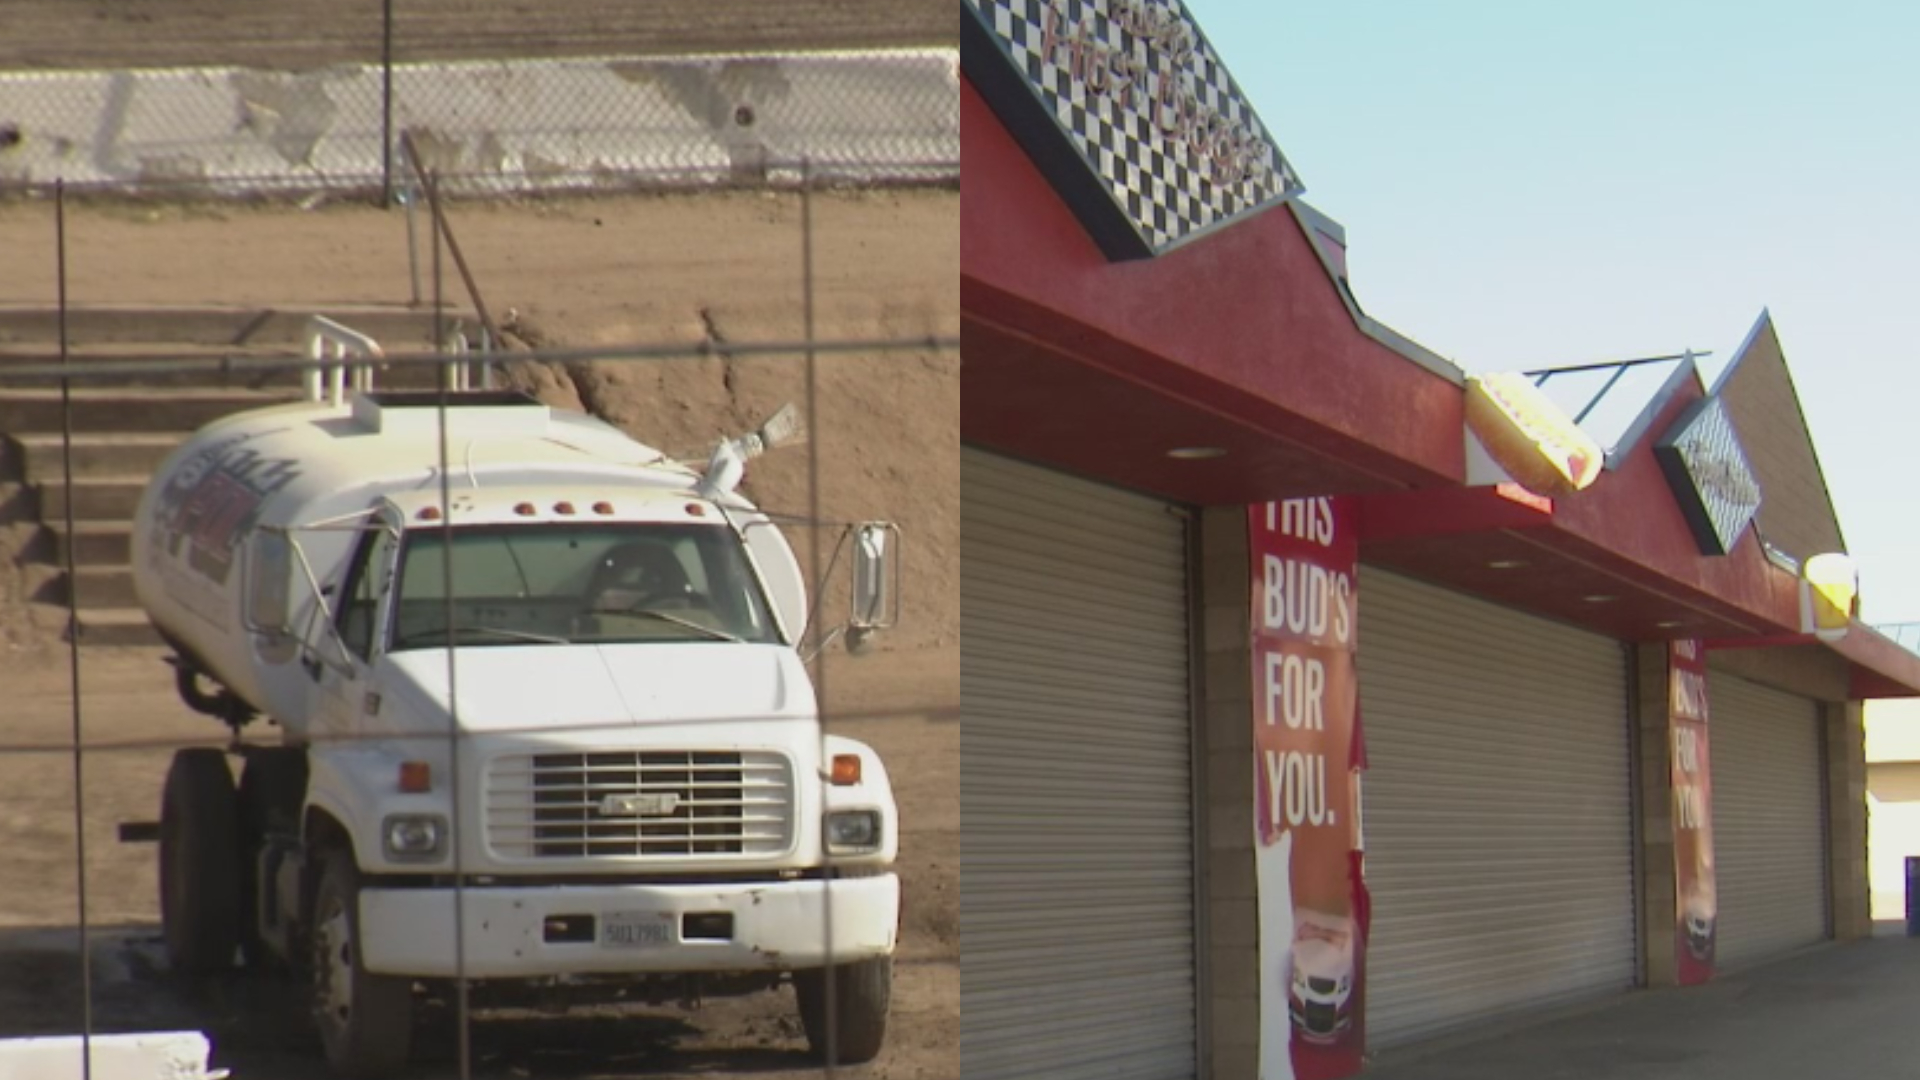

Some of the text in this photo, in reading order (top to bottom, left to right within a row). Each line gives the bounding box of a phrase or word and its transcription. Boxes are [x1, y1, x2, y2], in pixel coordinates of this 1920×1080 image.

[1263, 553, 1349, 644] BUD'S
[1265, 652, 1325, 731] FOR
[1266, 751, 1336, 827] YOU.
